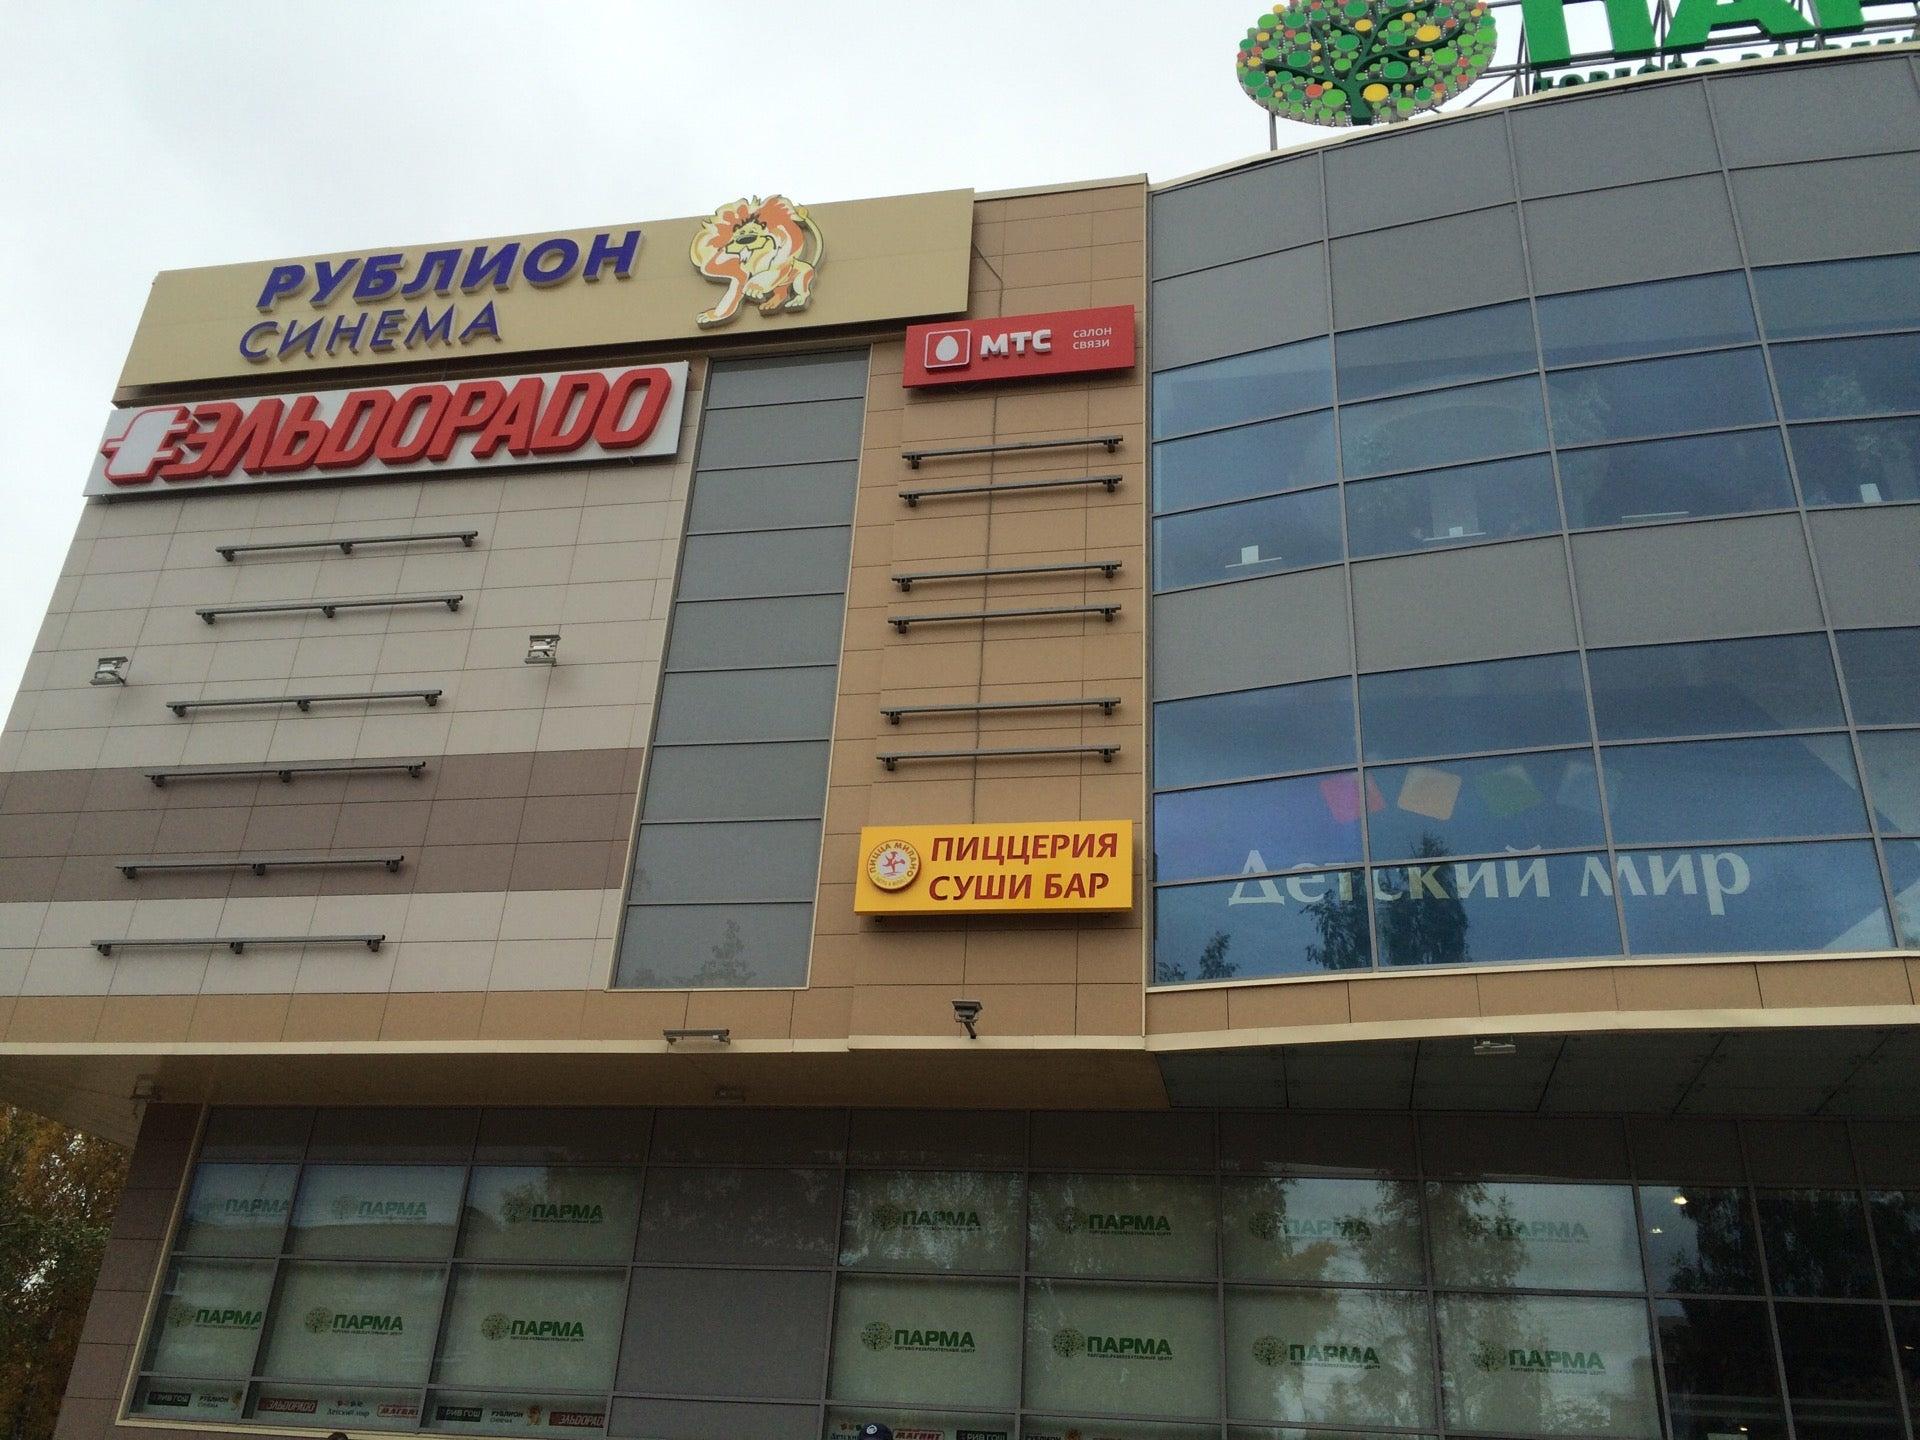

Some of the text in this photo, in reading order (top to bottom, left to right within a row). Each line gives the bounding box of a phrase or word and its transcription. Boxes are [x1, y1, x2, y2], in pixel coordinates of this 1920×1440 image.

[256, 230, 641, 312] РУБЛИОН
[240, 301, 502, 363] СИНЕМА
[1072, 326, 1112, 339] салон
[981, 329, 1052, 357] МТС
[1072, 338, 1110, 350] связи
[931, 832, 1119, 866] ПИЦЦЕРИЯ
[929, 873, 1033, 901] СУШИ
[1044, 872, 1110, 899] БАР
[1228, 843, 1753, 917] Детский мир
[358, 1200, 428, 1216] ПАРМА
[532, 1203, 603, 1219] ПАРМА
[902, 1209, 980, 1227] ПАРМА
[1088, 1213, 1171, 1231] ПАРМА
[195, 1309, 263, 1325] ПАРМА
[332, 1314, 404, 1331] ПАРМА
[511, 1320, 584, 1337] ПАРМА
[894, 1329, 975, 1348] ПАРМА
[1087, 1336, 1173, 1355] ПАРМА
[1289, 1344, 1380, 1364] ПАРМА
[1509, 1349, 1605, 1370] ПАРМА
